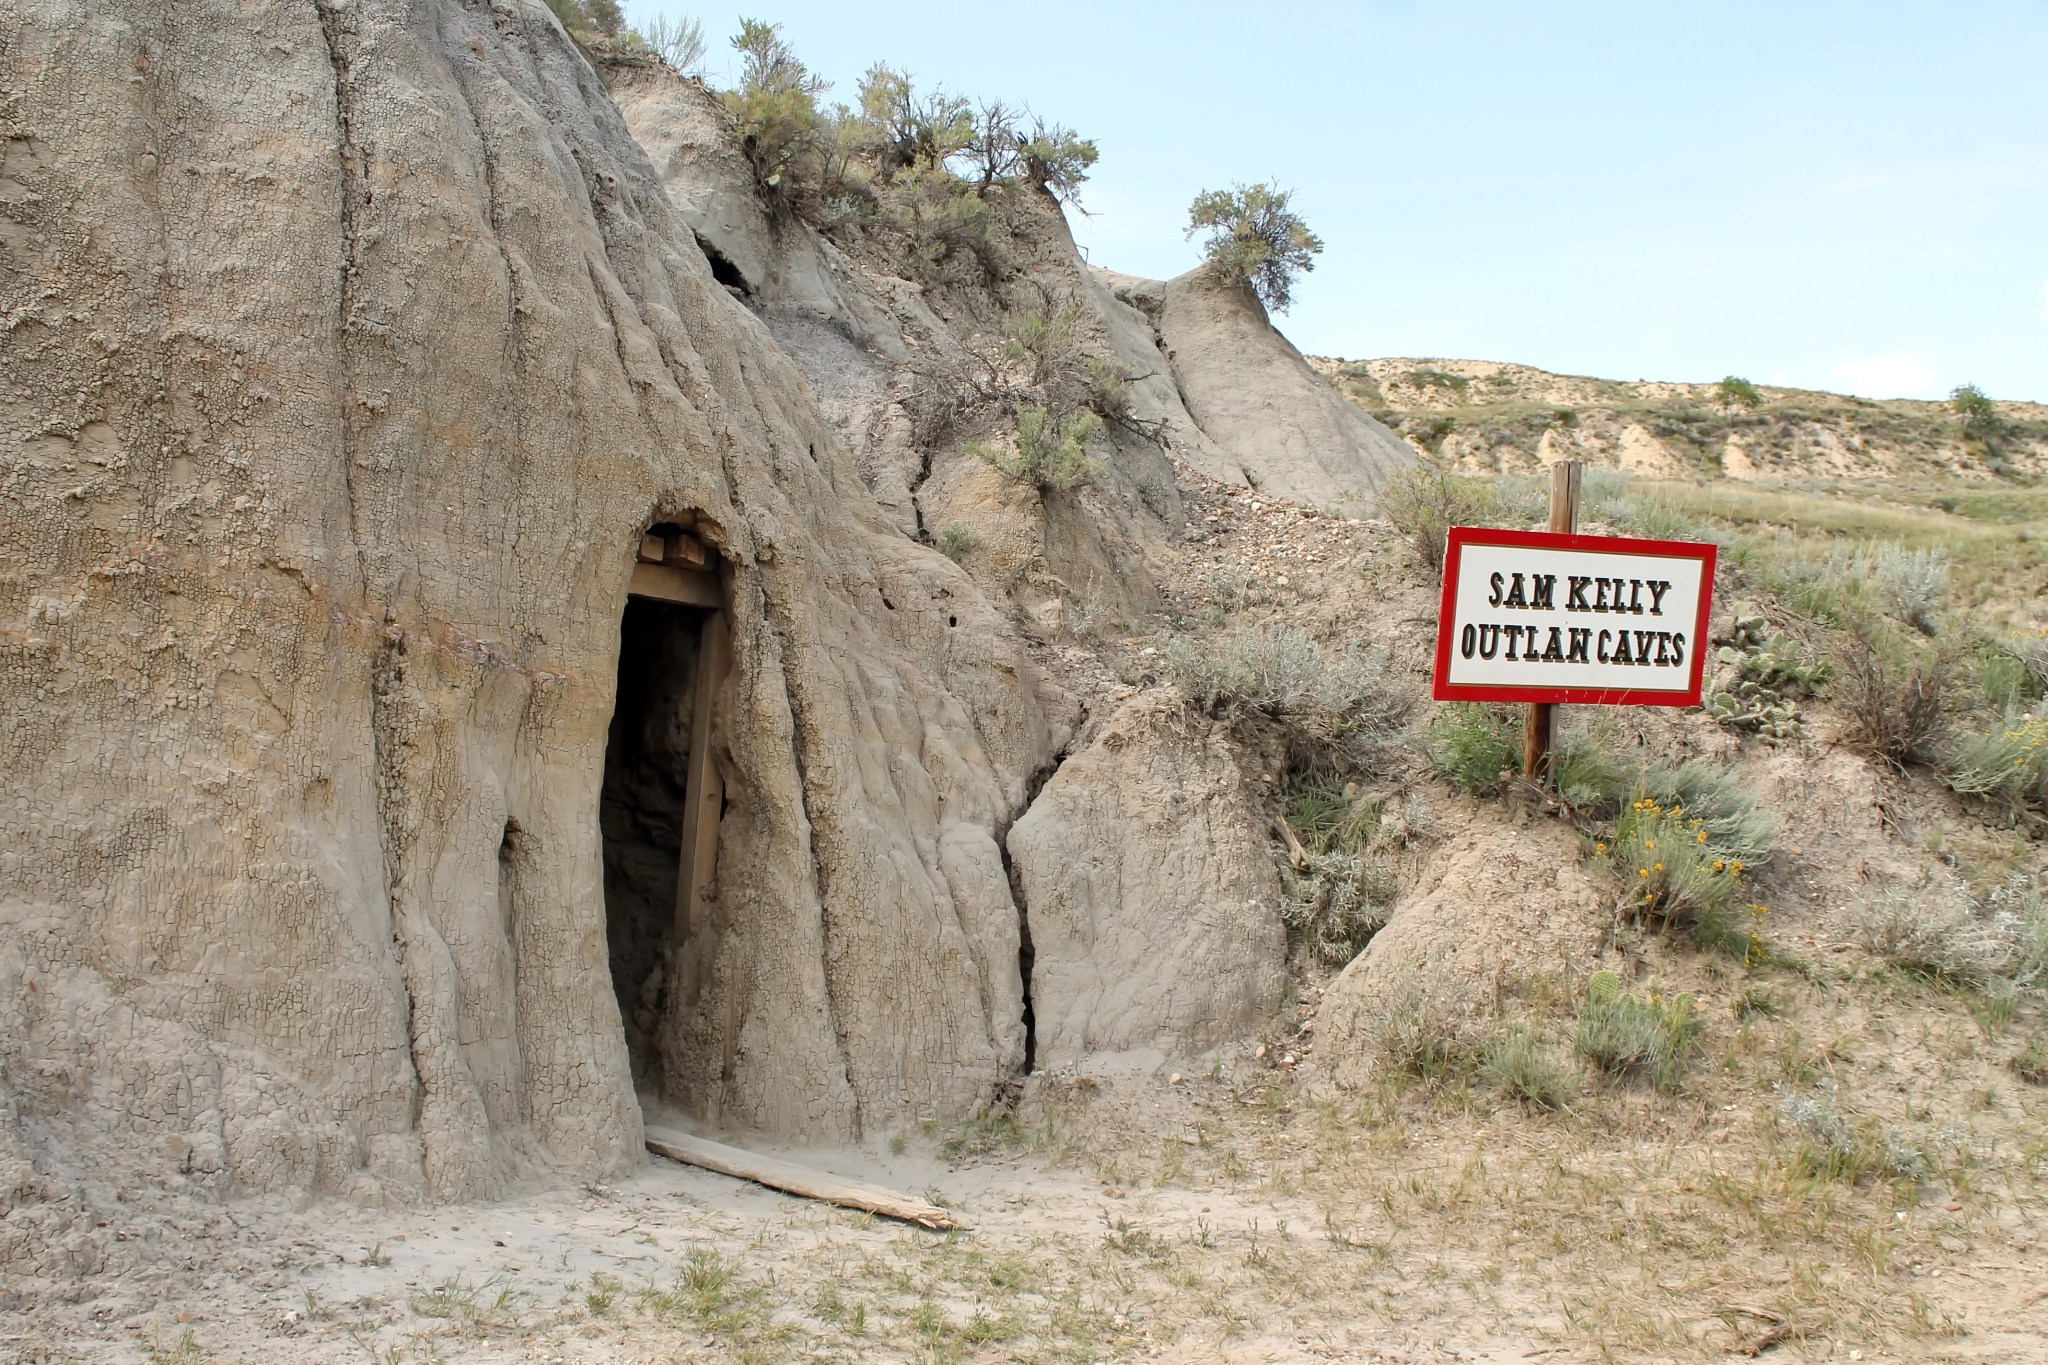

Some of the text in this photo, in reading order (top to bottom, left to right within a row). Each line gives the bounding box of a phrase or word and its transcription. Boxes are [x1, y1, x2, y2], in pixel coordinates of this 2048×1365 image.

[1489, 572, 1672, 616] SAM KELLY
[1461, 623, 1686, 668] OUTLAW CAVES
